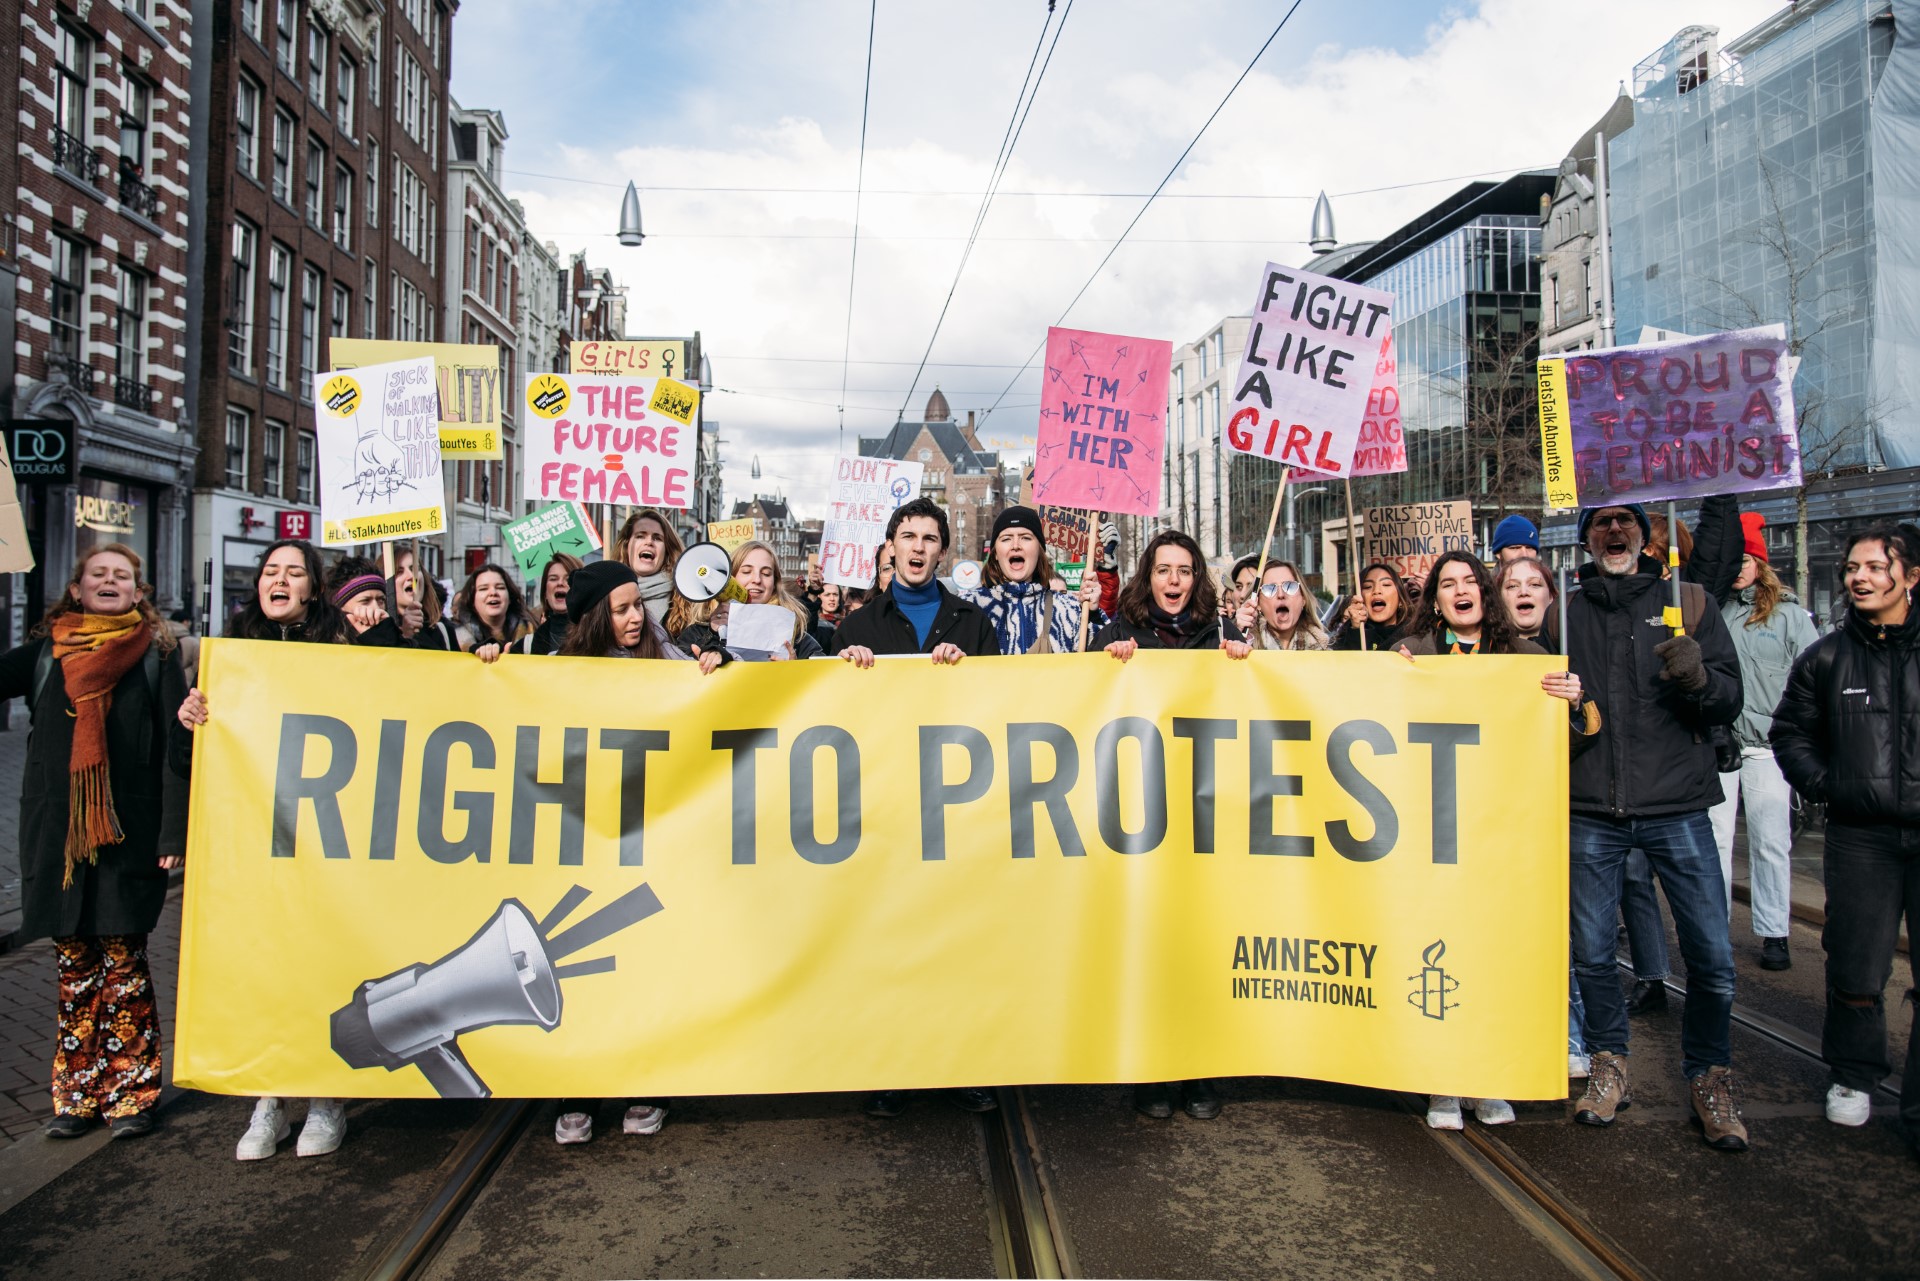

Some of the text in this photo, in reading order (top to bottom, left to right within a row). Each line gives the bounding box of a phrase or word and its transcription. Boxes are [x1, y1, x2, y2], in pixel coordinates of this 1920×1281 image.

[1261, 271, 1390, 338] FIGHT
[580, 343, 651, 369] Girls
[1247, 322, 1354, 389] LIKE
[390, 365, 428, 387] SICK
[1081, 373, 1120, 403] I'M
[1235, 370, 1272, 409] A
[1566, 349, 1778, 401] PROUD
[386, 393, 437, 416] WALKING
[388, 386, 405, 400] OF
[436, 364, 498, 423] LITY
[577, 385, 646, 421] THE
[393, 414, 436, 441] LIKE
[1062, 401, 1130, 433] WITH
[1538, 364, 1562, 483] #LetsTalkAboutYes
[1590, 388, 1775, 443] TO BE A
[439, 438, 477, 449] boutYes
[554, 419, 680, 457] FUTURE
[1068, 430, 1134, 471] HER
[1227, 406, 1341, 472] GIRL
[14, 463, 65, 474] DOUGLAS
[402, 440, 440, 479] THIS
[838, 458, 898, 484] DON'T
[541, 462, 689, 505] FEMALE
[839, 483, 889, 504] EVER
[286, 515, 304, 536] T
[508, 504, 567, 536] THIS IS WHAT
[831, 501, 885, 522] TAKE
[1416, 504, 1452, 520] JUST
[328, 520, 422, 540] #LetsTalkAboutYes
[513, 511, 571, 545] A FEMINIST
[514, 519, 576, 553] LOOKS LIKE
[1369, 522, 1405, 538] WANT
[1411, 521, 1430, 536] TO
[1435, 518, 1469, 534] HAVE
[820, 541, 880, 581] POW
[1369, 535, 1472, 557] FUNDING FOR
[271, 712, 1480, 866] RIGHT TO PROTEST
[1232, 935, 1378, 979] AMNESTY
[1232, 977, 1377, 1009] INTERNATIONAL
